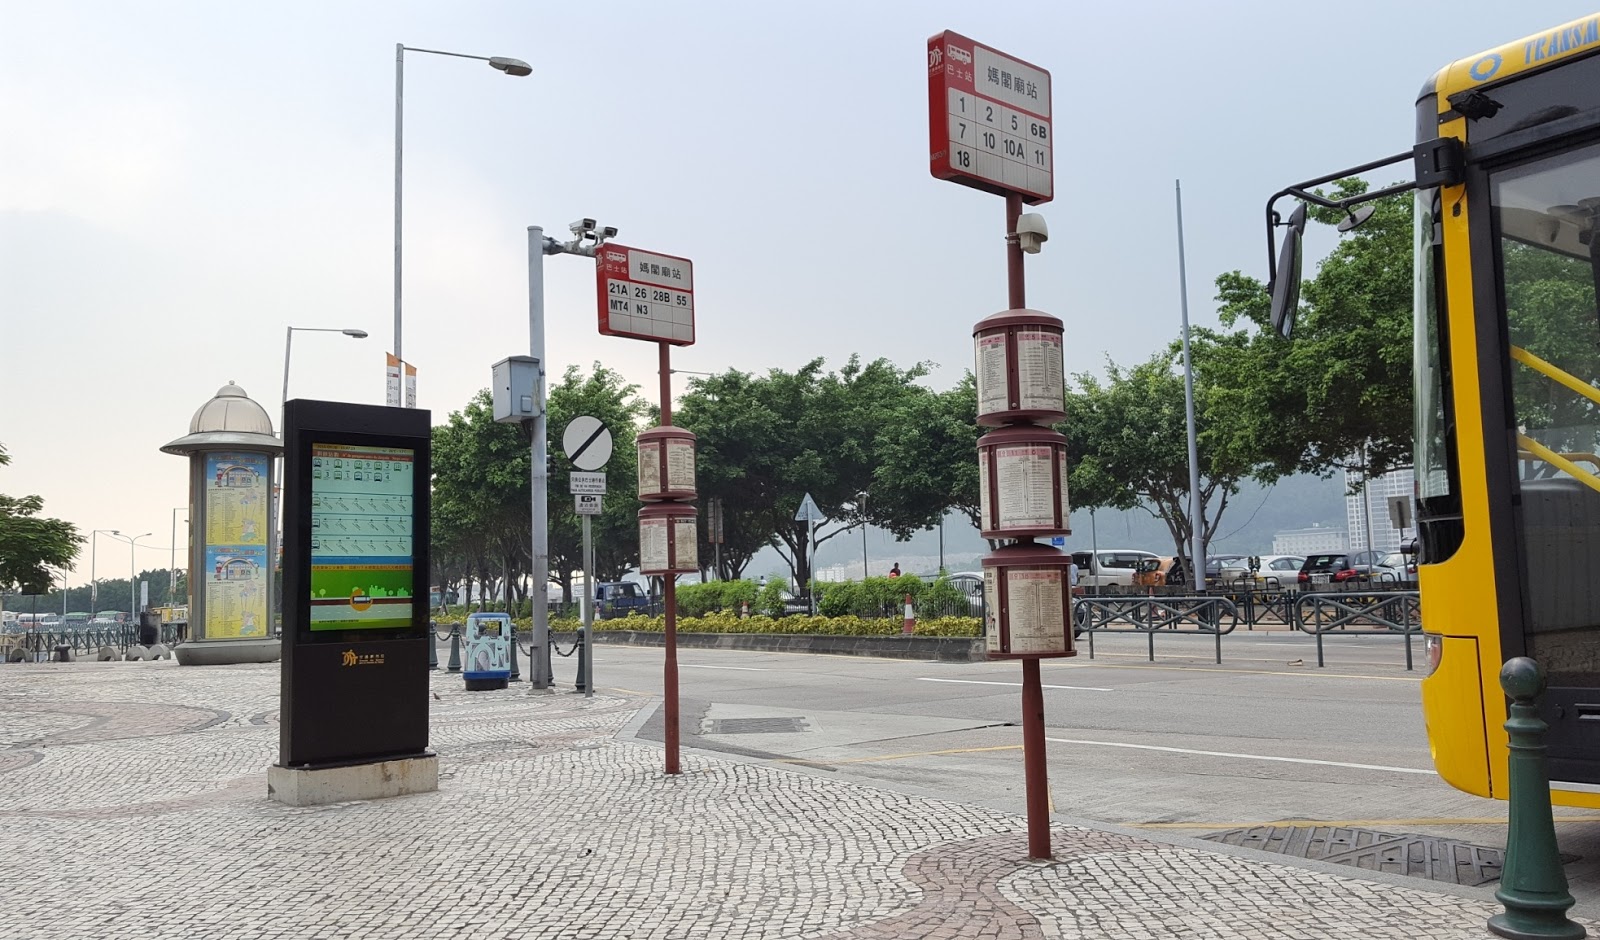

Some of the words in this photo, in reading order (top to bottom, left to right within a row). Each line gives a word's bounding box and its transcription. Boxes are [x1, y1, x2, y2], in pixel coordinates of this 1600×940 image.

[1524, 18, 1599, 65] TRANSM
[946, 63, 972, 83] 巴士站
[987, 65, 1038, 100] 媽閣廟站
[959, 97, 965, 112] 1
[986, 106, 993, 122] 2
[1011, 115, 1018, 131] 5
[1030, 123, 1047, 139] 6B
[959, 123, 966, 139] 7
[983, 132, 995, 149] 10
[1004, 139, 1025, 159] 10A
[1034, 150, 1044, 165] 11
[957, 151, 970, 168] 18
[606, 264, 627, 274] 巴士站
[639, 262, 681, 280] 媽閣廟站
[609, 283, 628, 296] 21A
[635, 287, 647, 299] 26
[653, 290, 670, 303] 28B
[676, 295, 687, 306] 55
[610, 299, 628, 312] MT4
[636, 304, 648, 315] N3
